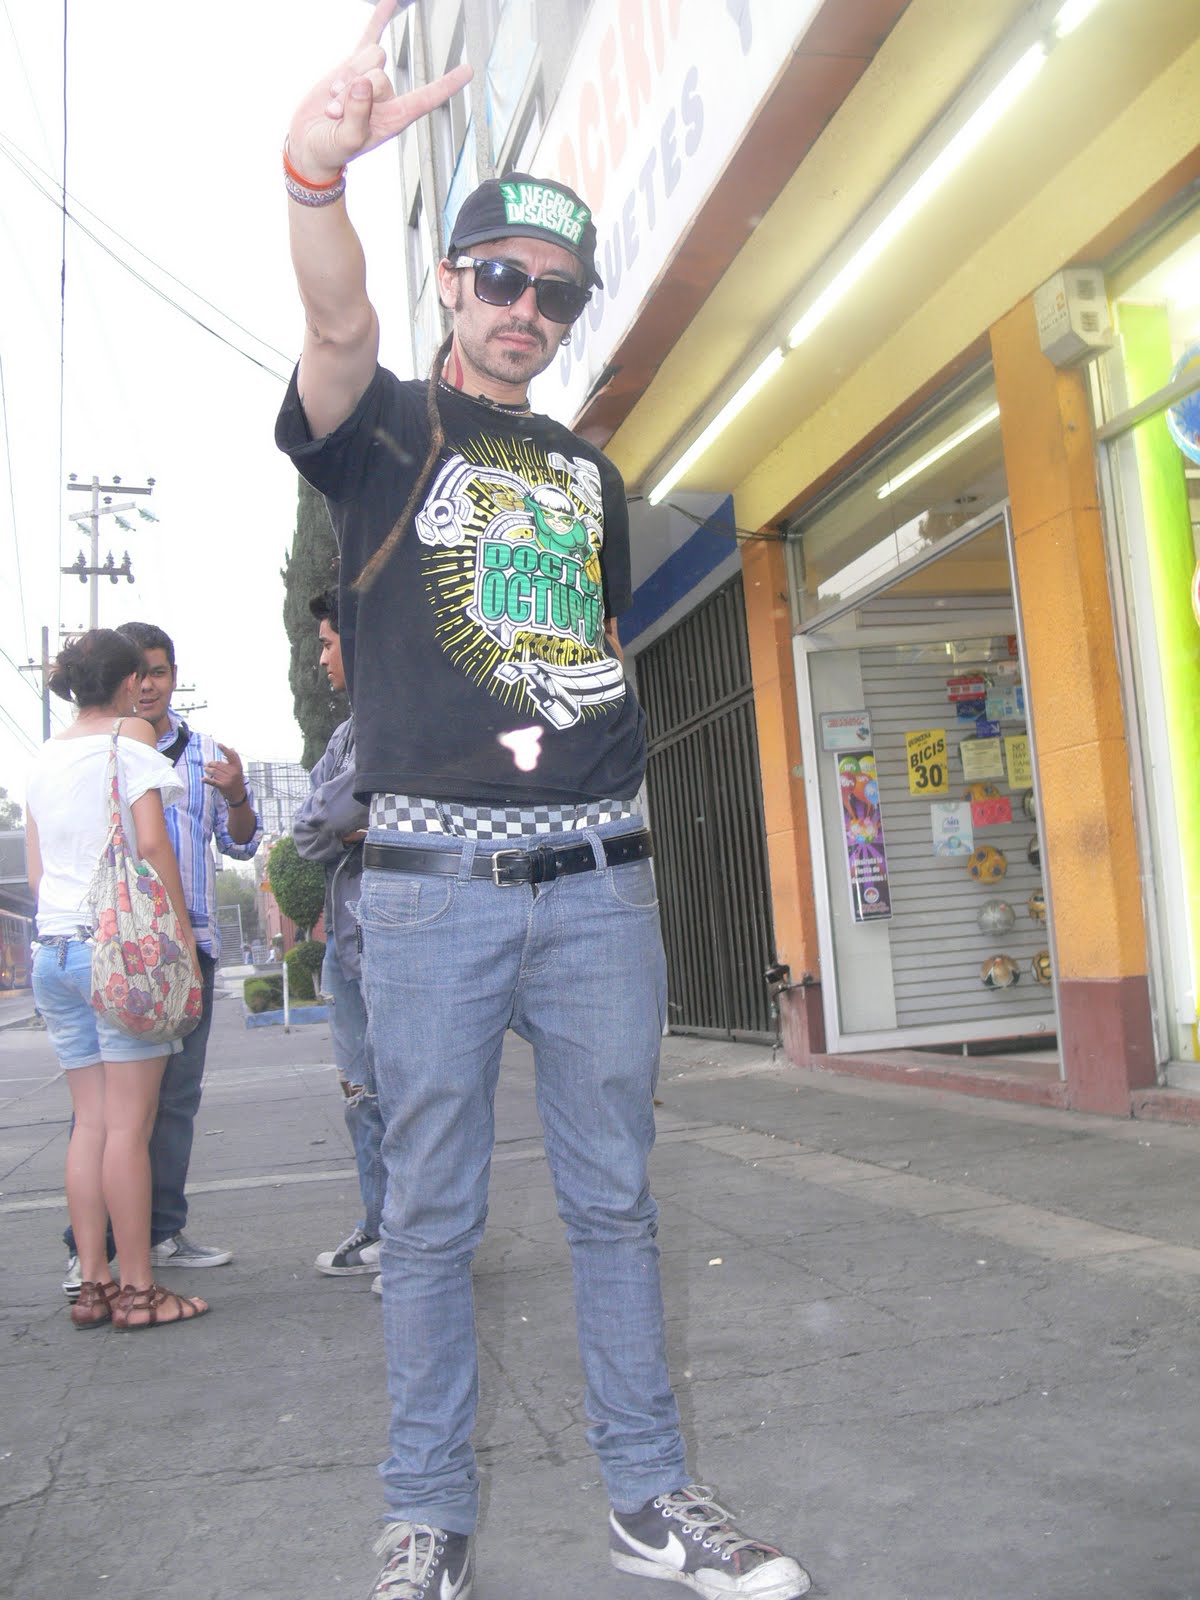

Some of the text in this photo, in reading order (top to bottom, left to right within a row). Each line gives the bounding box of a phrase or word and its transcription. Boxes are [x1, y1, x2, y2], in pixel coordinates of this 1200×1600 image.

[519, 185, 575, 218] NEGRO
[507, 202, 582, 243] DISASTER
[483, 542, 602, 600] DOCTO
[481, 570, 604, 645] OCTUPU
[911, 739, 944, 768] BICIS
[1012, 743, 1025, 751] NO
